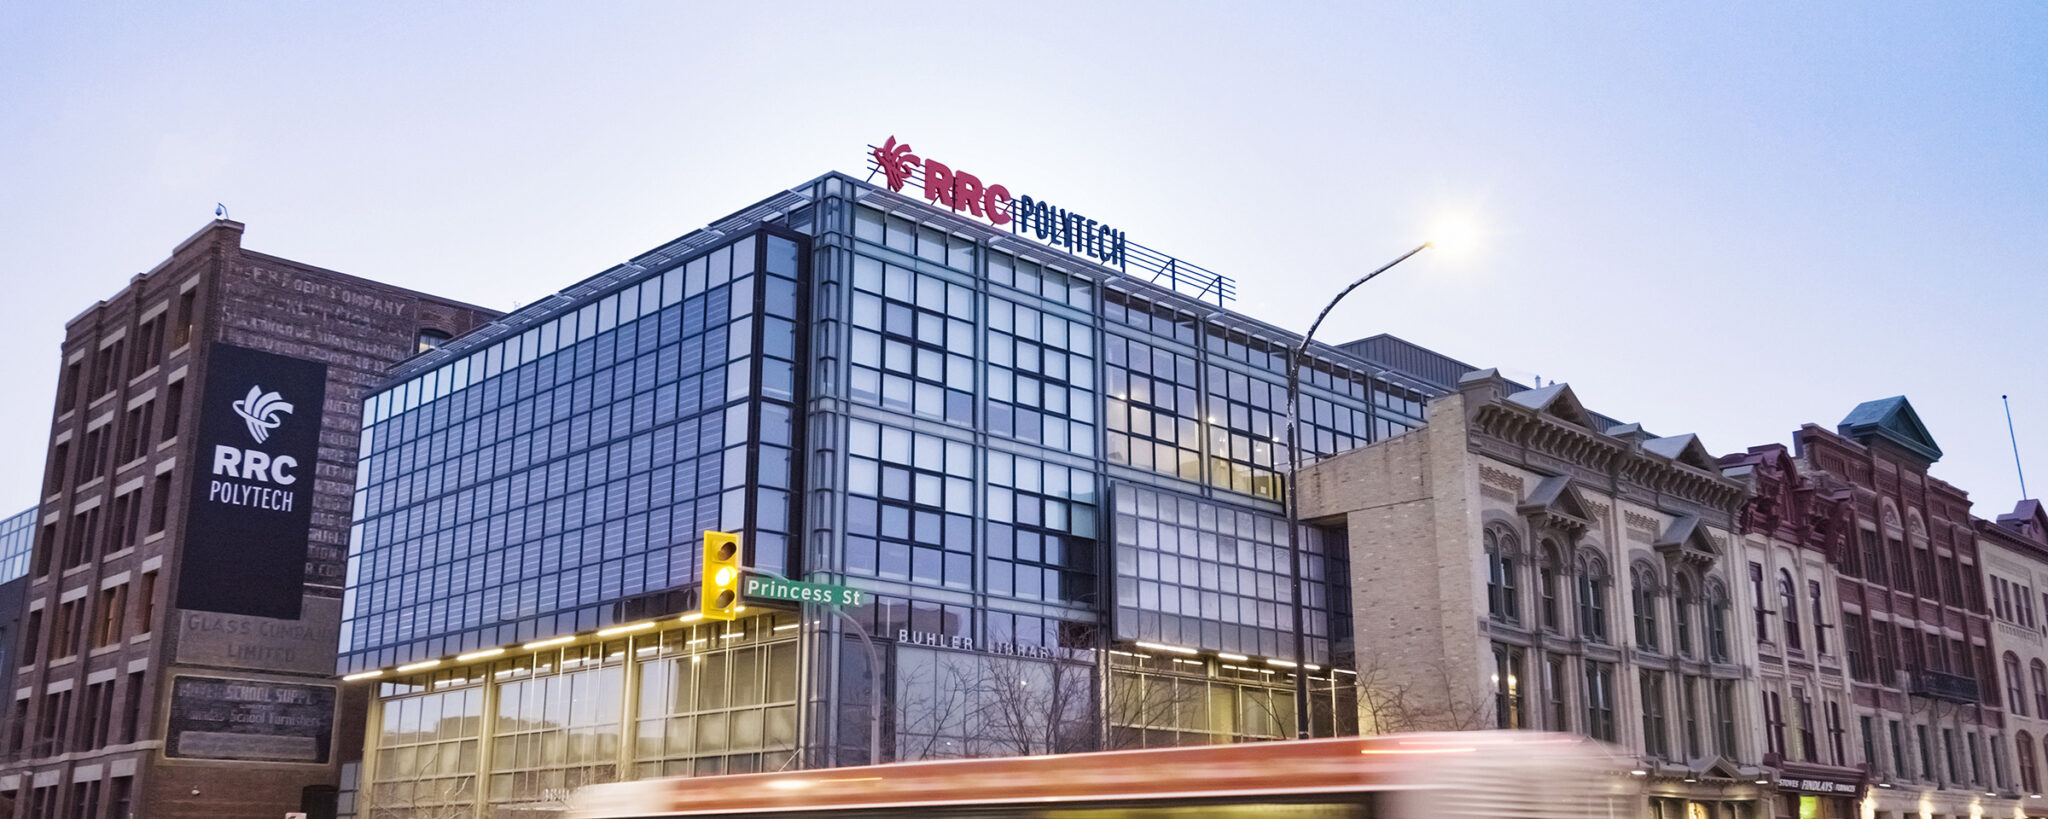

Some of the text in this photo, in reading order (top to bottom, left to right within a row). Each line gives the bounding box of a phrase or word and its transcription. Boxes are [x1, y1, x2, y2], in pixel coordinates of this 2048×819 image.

[924, 158, 1126, 268] RRC POLYTECH
[212, 444, 298, 485] RRC
[209, 480, 294, 513] POLYTECH
[747, 580, 861, 606] Princess St
[187, 614, 250, 634] GLASS
[898, 629, 974, 651] BUHLER
[225, 685, 272, 702] SCHOOL
[230, 710, 265, 724] School
[1801, 780, 1833, 792] FINDLAYS
